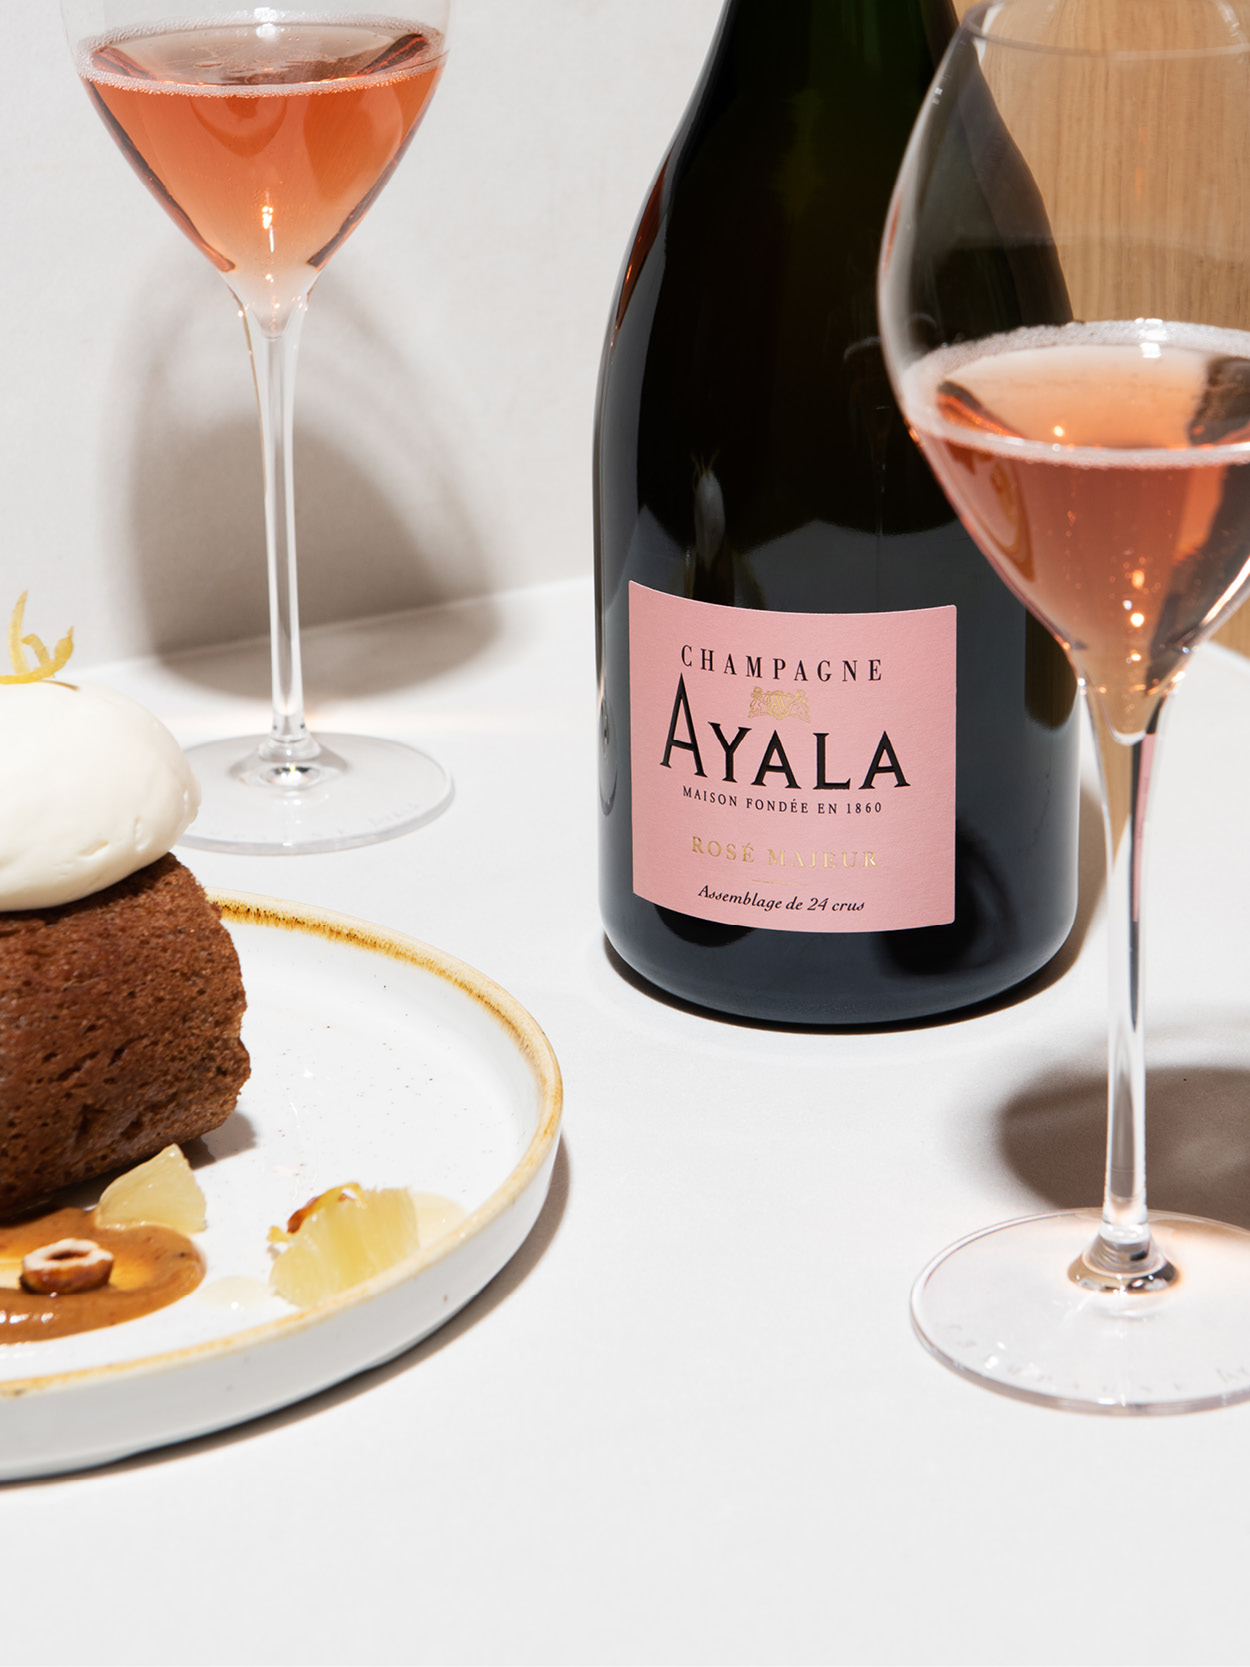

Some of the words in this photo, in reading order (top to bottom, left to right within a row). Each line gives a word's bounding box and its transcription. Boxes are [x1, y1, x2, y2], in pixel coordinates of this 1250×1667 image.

[681, 644, 882, 682] CHAMPAGNE
[659, 672, 911, 790] AYALA
[682, 785, 737, 807] MAISON
[746, 798, 809, 814] FONDÉE
[817, 802, 837, 814] EN
[846, 801, 882, 814] 1860
[691, 836, 755, 863] ROSÉ
[767, 848, 878, 868] MAJEUR
[697, 885, 782, 911] Assemblage
[785, 898, 803, 910] de
[807, 897, 828, 911] 24
[832, 902, 865, 912] crus
